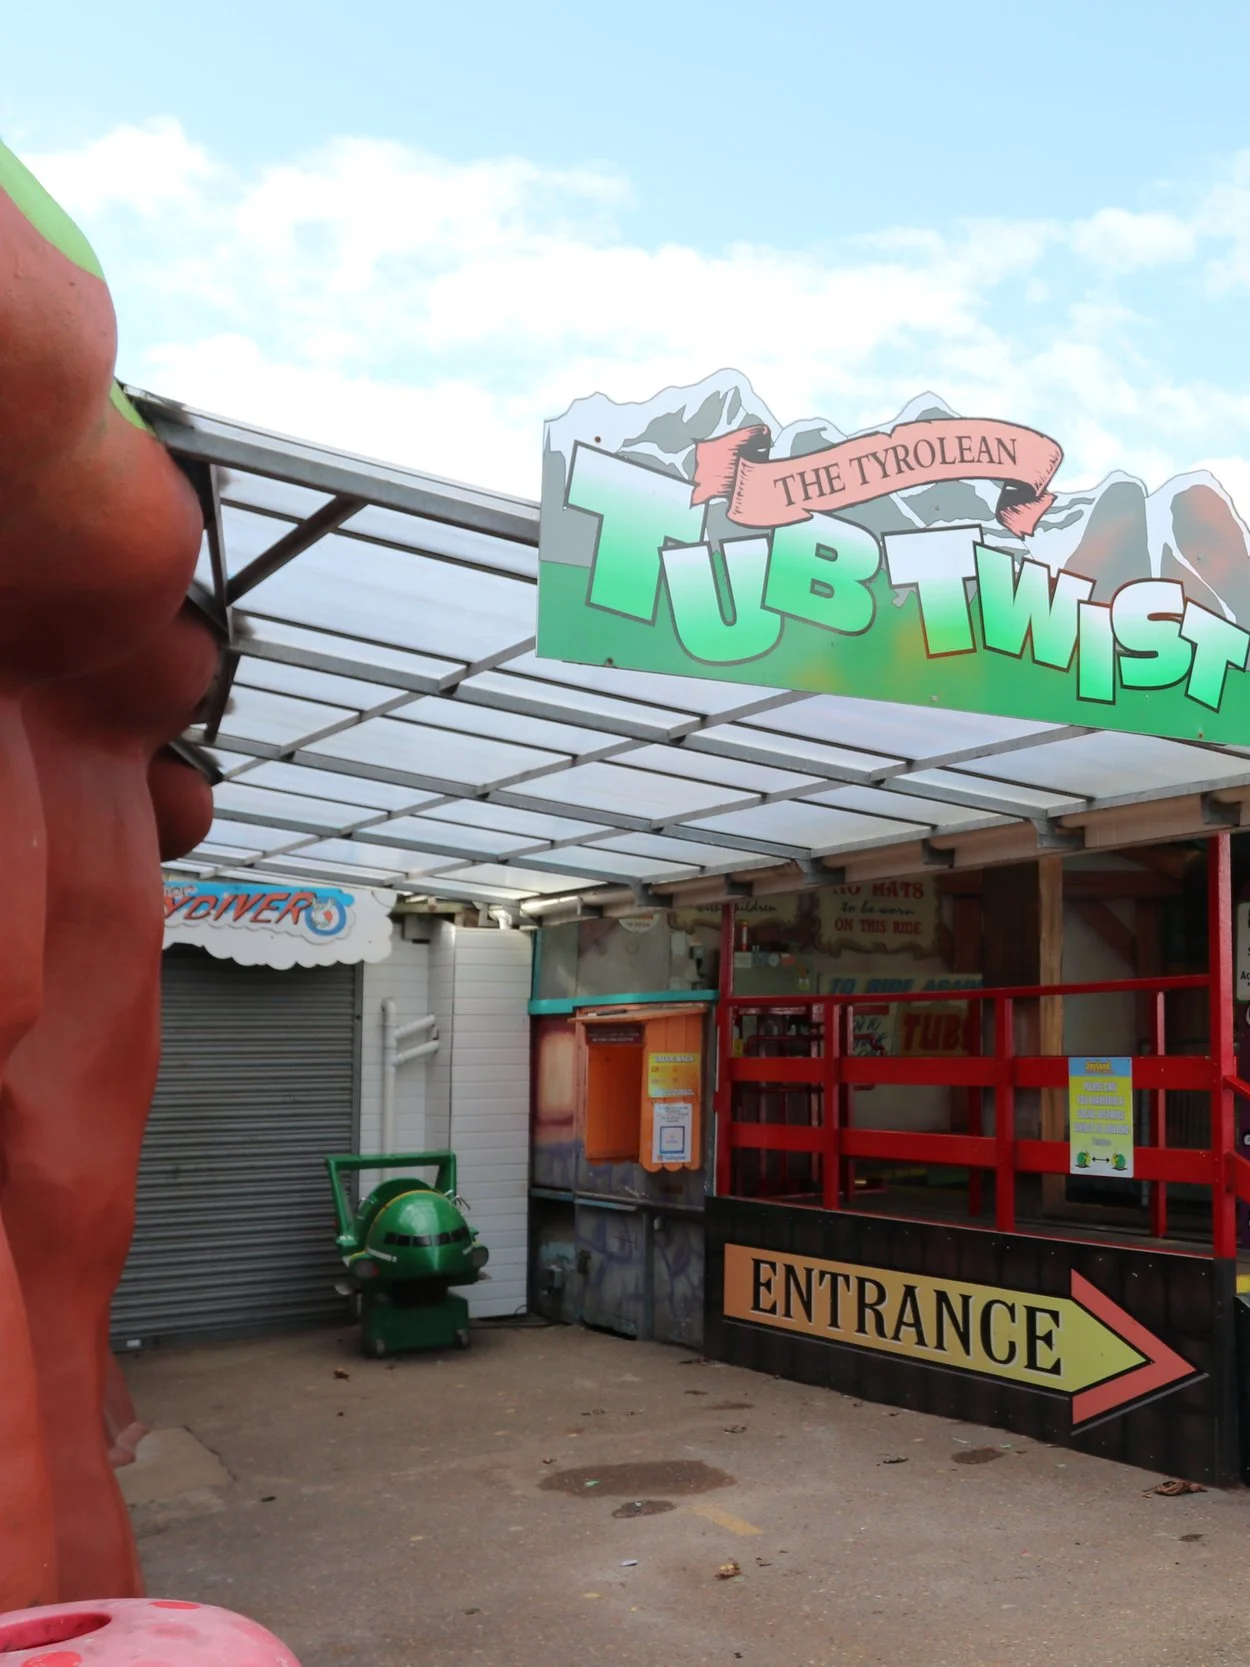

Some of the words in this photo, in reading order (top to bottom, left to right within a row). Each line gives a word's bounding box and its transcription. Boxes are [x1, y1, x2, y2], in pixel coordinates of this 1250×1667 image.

[774, 461, 847, 507] THE
[848, 436, 1019, 493] TYROLEAN
[565, 440, 883, 665] TUB
[164, 892, 316, 926] YDIVER
[834, 917, 853, 932] ON
[859, 918, 886, 933] THIS
[892, 920, 922, 935] RIDE
[751, 1257, 1065, 1378] ENTRANCE
